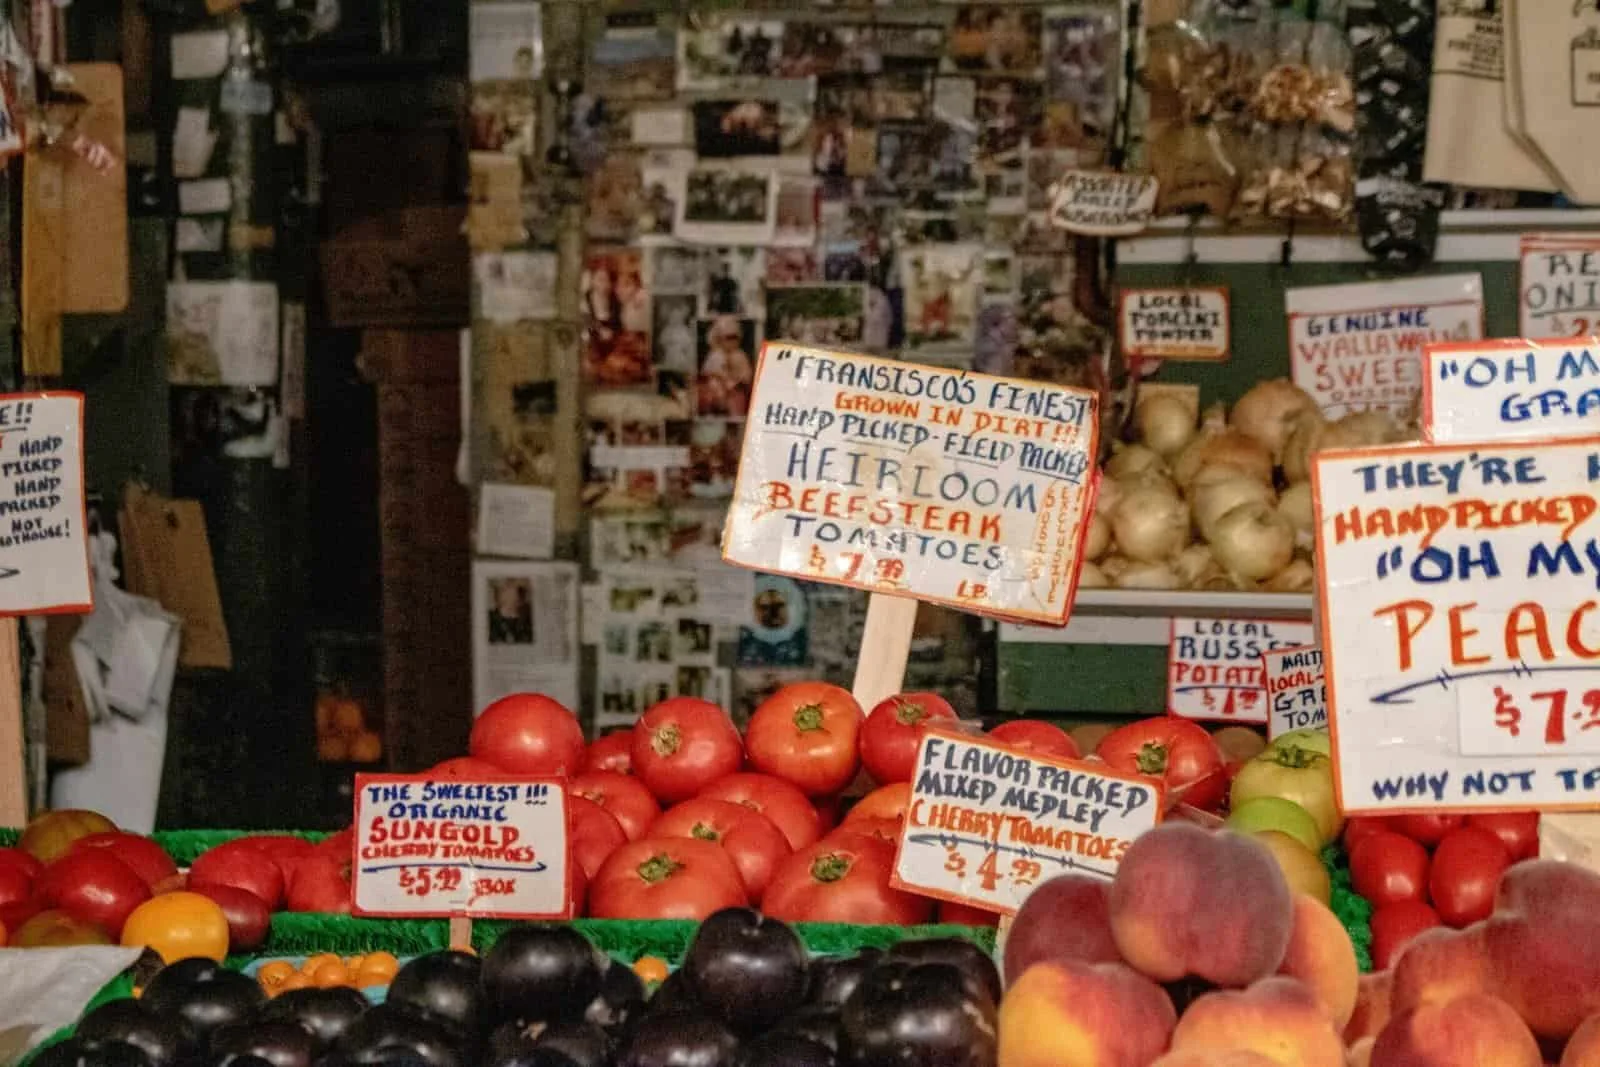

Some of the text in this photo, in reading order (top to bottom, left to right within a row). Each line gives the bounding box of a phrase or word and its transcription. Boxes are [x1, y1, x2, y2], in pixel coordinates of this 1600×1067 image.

[1139, 295, 1204, 309] LOCAL
[1128, 311, 1220, 330] PORCINI
[1307, 307, 1430, 337] GENUINE
[1298, 334, 1391, 363] WALLA
[835, 391, 920, 419] GROWN
[928, 405, 963, 427] IN
[19, 435, 63, 457] HAND
[765, 402, 835, 439] HAND
[1019, 441, 1089, 479] PACKED
[2, 457, 62, 477] PICKED
[787, 440, 1038, 514] HEIRLOOM
[1353, 452, 1546, 494] THEY'RE
[14, 476, 61, 497] HAND
[11, 516, 43, 534] NOT
[755, 481, 1001, 542] BEEFSTEAK
[785, 514, 1004, 569] TOMATOES
[1195, 620, 1273, 638] LOCAL
[367, 784, 411, 803] THE
[422, 781, 521, 801] SWEETEST
[924, 739, 1149, 817] FLAVOR PACKED
[1372, 769, 1449, 800] WHY
[1462, 769, 1536, 796] NOT
[388, 803, 508, 821] ORGANIC
[915, 769, 1108, 832] MIXED MEDLEY
[369, 816, 520, 848] SUNGOLD
